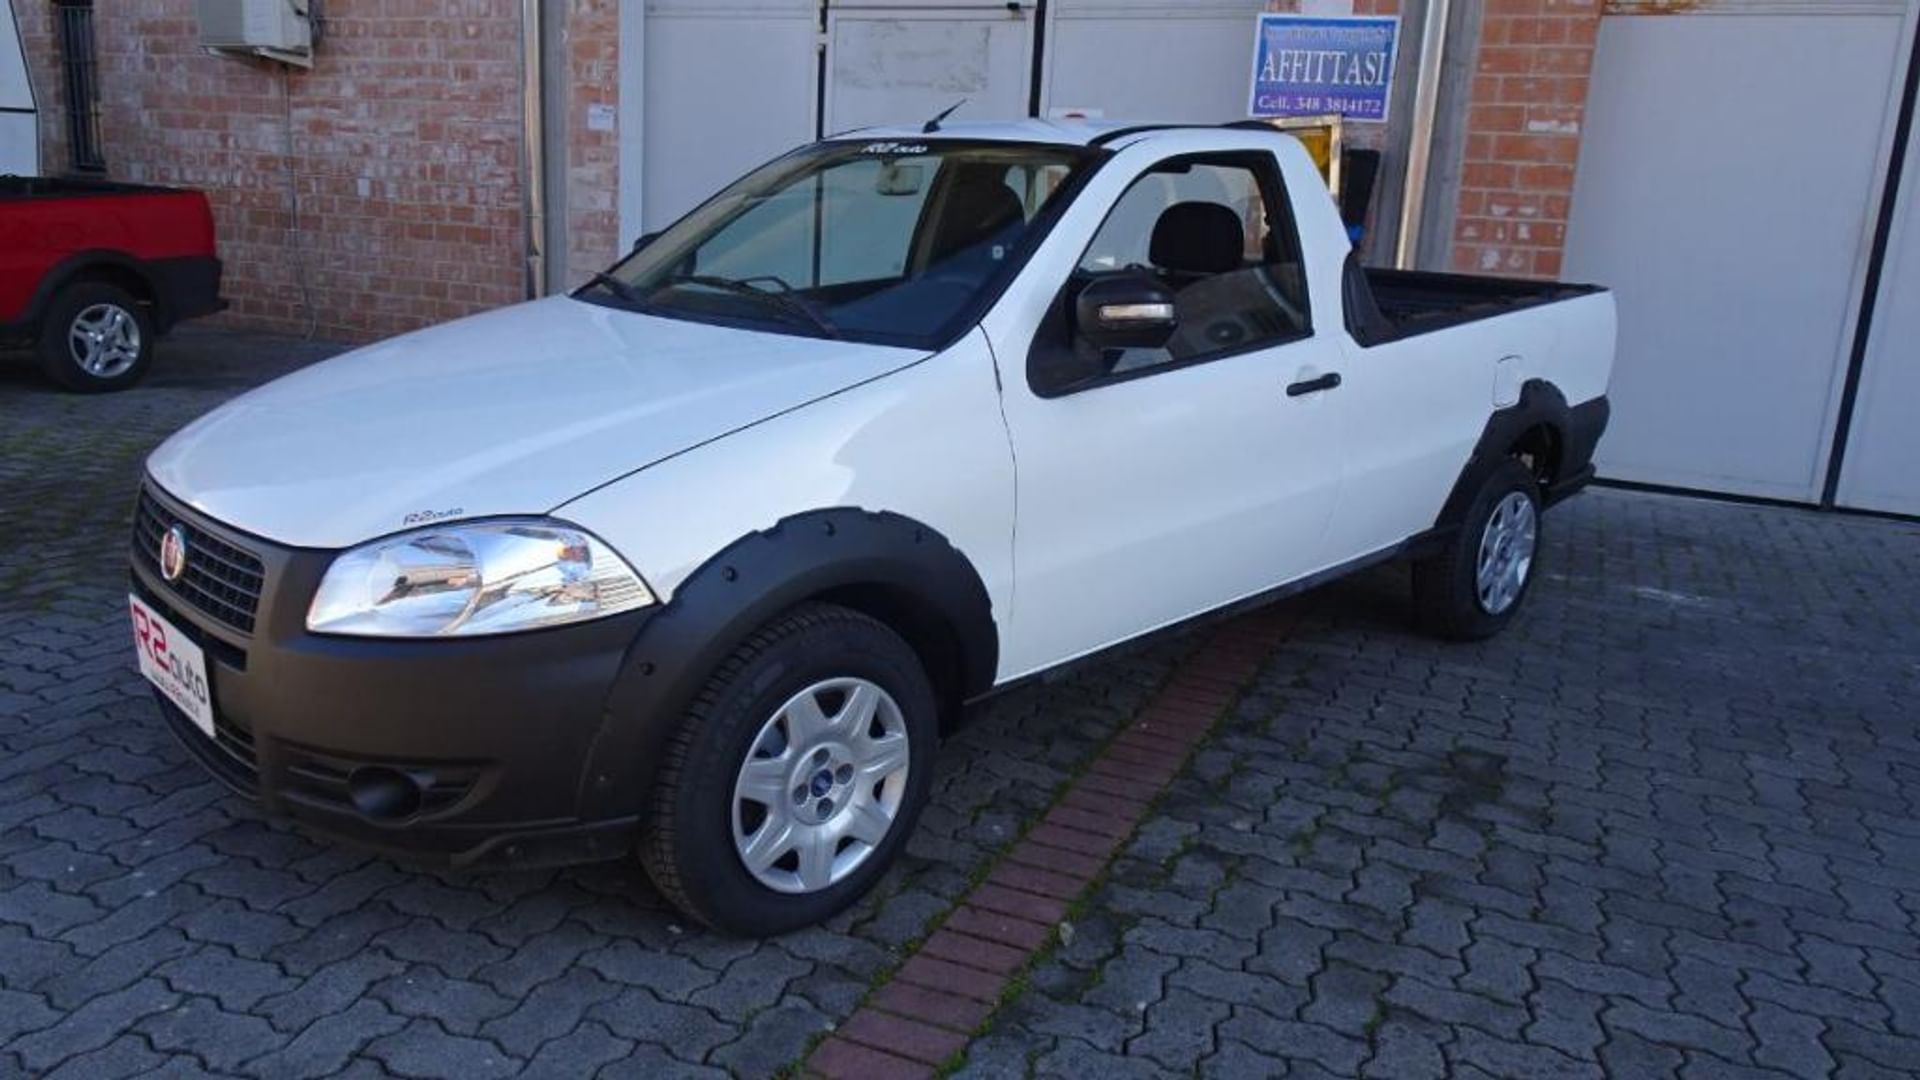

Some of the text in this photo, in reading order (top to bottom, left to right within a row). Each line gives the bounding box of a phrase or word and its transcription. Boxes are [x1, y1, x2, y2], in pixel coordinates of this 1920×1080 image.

[1259, 50, 1388, 87] AFFITTASI
[1258, 95, 1291, 110] Cell.
[1297, 97, 1321, 112] 348
